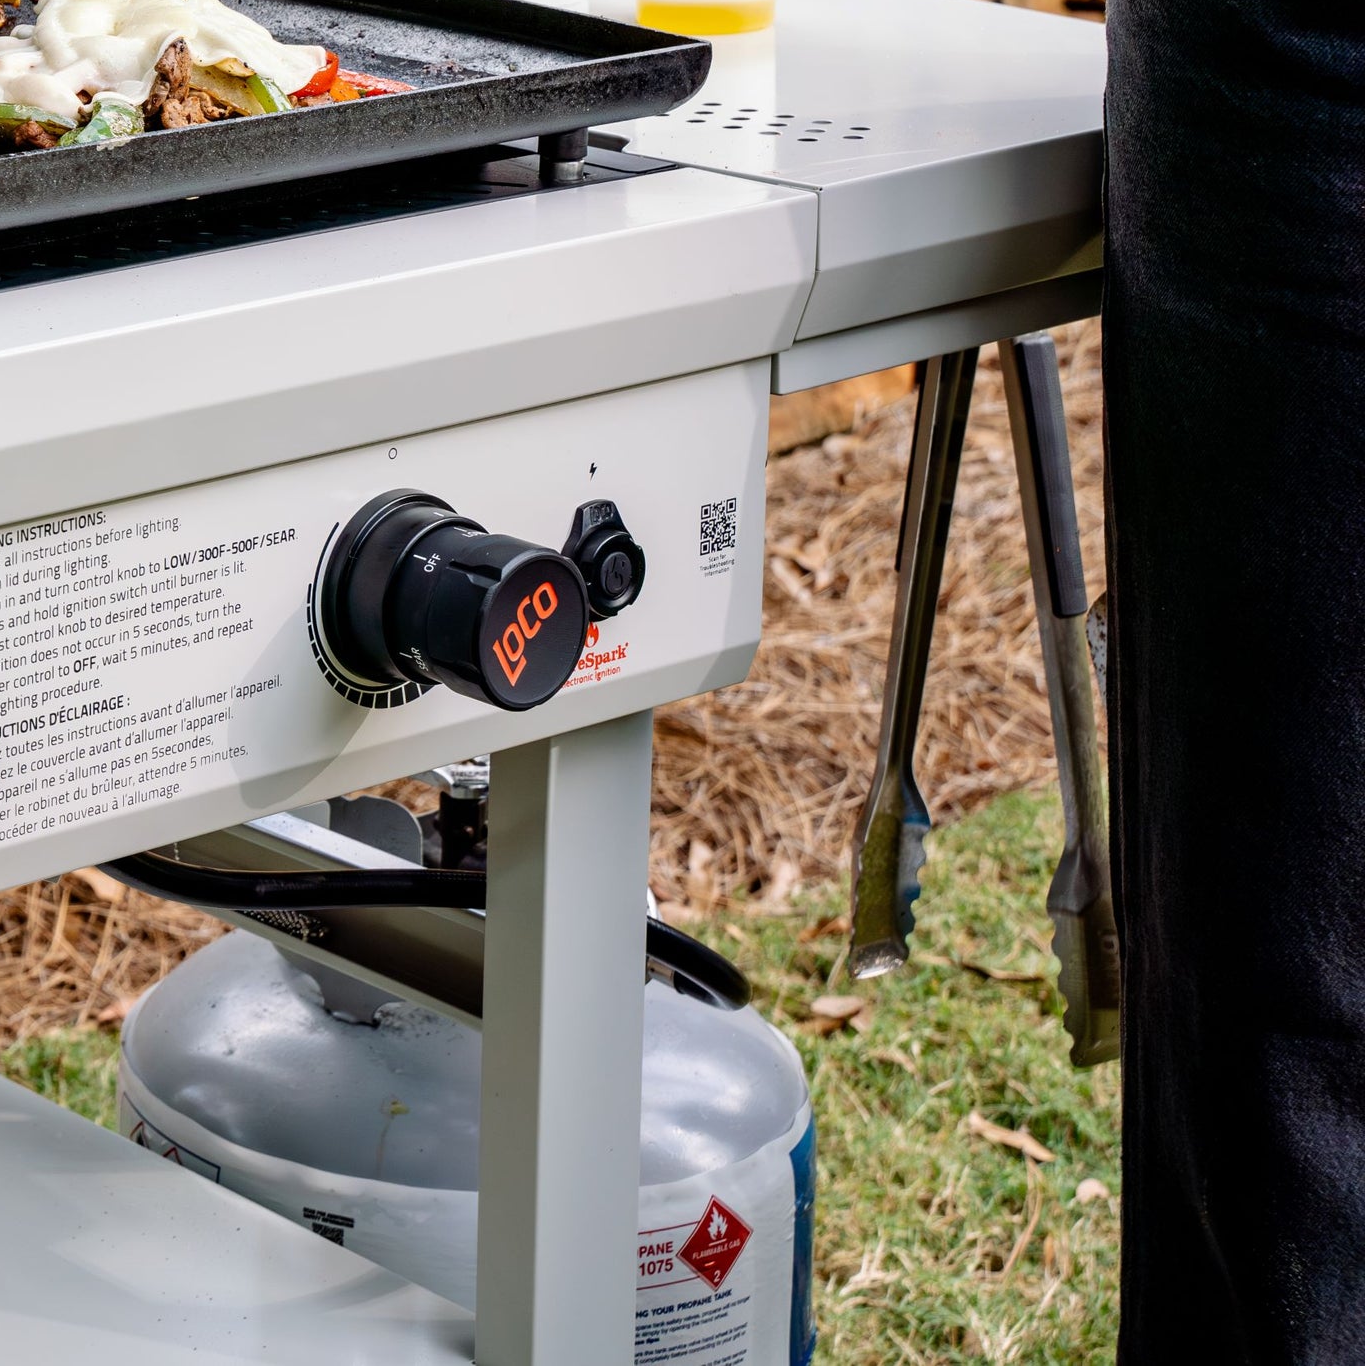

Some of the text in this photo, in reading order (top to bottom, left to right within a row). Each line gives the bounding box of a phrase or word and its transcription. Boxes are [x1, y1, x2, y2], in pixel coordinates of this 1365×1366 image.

[5, 551, 17, 567] all
[22, 538, 92, 563] instructions
[95, 528, 132, 546] before
[136, 518, 181, 539] lighting.
[17, 510, 106, 543] INSTRUCTIONS:
[6, 572, 19, 588] lid
[23, 562, 61, 585] during
[64, 554, 111, 576] lighting.
[423, 553, 441, 572] OFF
[5, 595, 15, 608] in
[19, 587, 43, 605] and
[45, 584, 69, 598] turn
[71, 570, 113, 592] control
[117, 563, 145, 582] knob
[149, 562, 160, 574] to
[8, 610, 30, 628] and
[34, 604, 59, 622] hold
[63, 596, 106, 618] ignition
[110, 583, 147, 604] switch
[151, 575, 176, 593] until
[181, 569, 218, 586] burner
[221, 564, 230, 576] is
[234, 560, 247, 574] lit.
[11, 625, 54, 647] control
[58, 618, 87, 636] knob
[89, 616, 101, 628] to
[104, 603, 147, 625] desired
[151, 586, 225, 614] temperature.
[31, 648, 58, 664] does
[63, 640, 82, 656] not
[85, 634, 116, 650] occur
[119, 629, 131, 642] in
[133, 625, 140, 638] 5
[143, 614, 192, 636] seconds,
[195, 609, 219, 625] turn
[223, 602, 241, 616] the
[13, 666, 54, 688] control
[56, 666, 70, 677] to
[73, 656, 99, 673] OFF,
[102, 649, 127, 666] wait
[131, 646, 137, 659] 5
[141, 636, 190, 656] minutes,
[193, 626, 214, 644] and
[218, 618, 253, 638] repeat
[578, 645, 627, 670] eSpark
[42, 678, 103, 706] procedure.
[563, 674, 593, 689] ectronic
[5, 739, 43, 758] toutes
[48, 731, 64, 746] les
[68, 715, 137, 742] instructions
[140, 704, 173, 722] avant
[175, 691, 228, 714] d'allumer
[231, 674, 282, 700] l'appareil.
[49, 695, 124, 726] D'ÉCLAIRAGE
[17, 762, 27, 775] le
[31, 746, 85, 771] couvercle
[89, 736, 122, 756] avant
[125, 724, 178, 746] d'allumer
[181, 707, 233, 732] l'appareil.
[15, 804, 24, 816] le
[29, 791, 70, 812] robinet
[73, 786, 87, 800] du
[92, 776, 135, 796] brûleur,
[138, 762, 187, 783] attendre
[190, 756, 197, 769] 5
[201, 746, 248, 766] minutes,
[41, 777, 55, 789] ne
[59, 763, 107, 784] s'allume
[109, 756, 132, 774] pas
[134, 752, 148, 764] en
[41, 816, 55, 829] de
[59, 803, 108, 824] nouveau
[110, 797, 119, 810] à
[123, 780, 181, 807] l'allumage.
[637, 1241, 674, 1259] PANE
[692, 1238, 741, 1260] FLAMMABLE GAS
[639, 1258, 674, 1276] 1075
[714, 1270, 721, 1282] 2
[652, 1305, 674, 1316] YOUR
[677, 1295, 712, 1310] PROPANE
